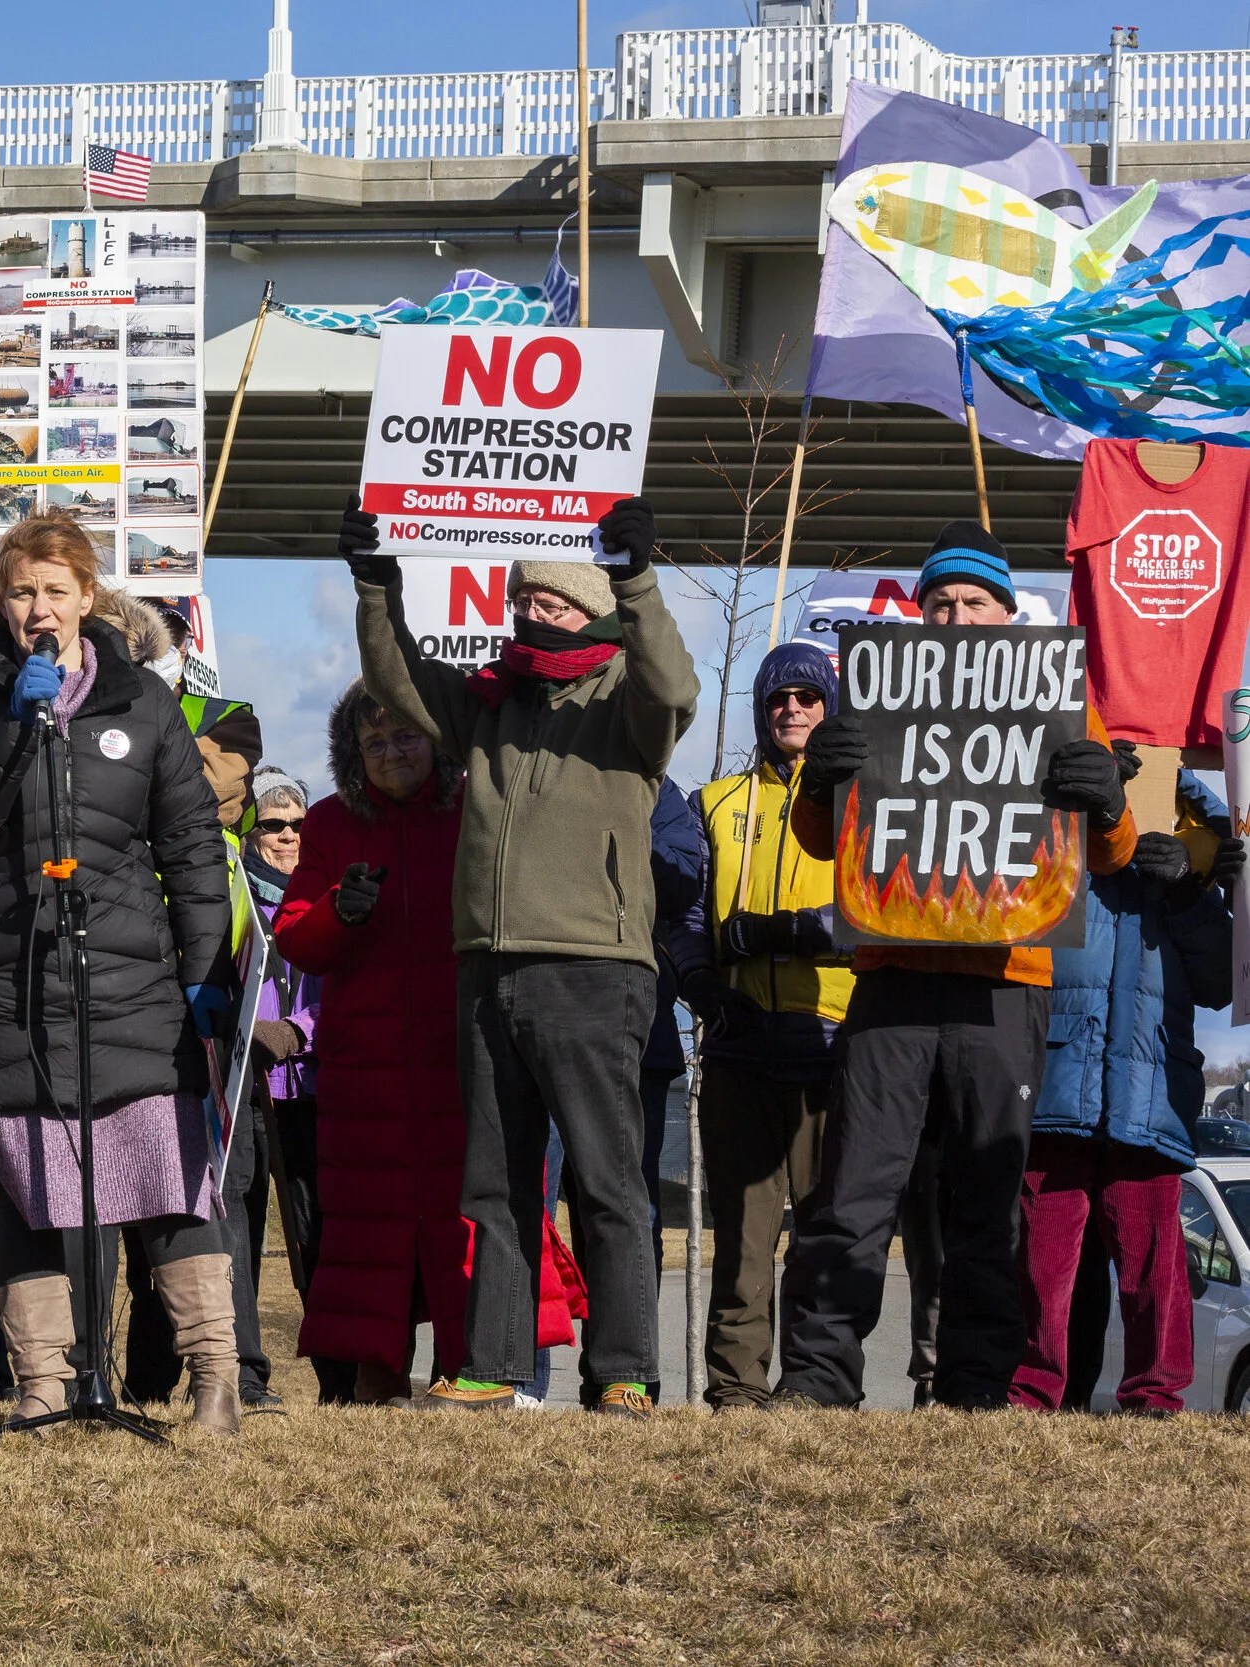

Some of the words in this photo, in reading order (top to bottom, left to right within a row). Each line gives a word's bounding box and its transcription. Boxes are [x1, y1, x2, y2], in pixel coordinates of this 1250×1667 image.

[26, 291, 89, 299] COMPRESSOR
[441, 335, 582, 410] NO
[381, 415, 632, 451] COMPRESSOR
[16, 469, 47, 477] About
[87, 468, 104, 476] Air.
[422, 449, 577, 482] STATION
[402, 489, 468, 511] South
[472, 493, 545, 518] Shore,
[551, 496, 589, 516] MA
[389, 522, 594, 548] NOCompressor.com
[1133, 533, 1200, 558] STOP
[1126, 558, 1178, 569] FRACKED
[1182, 559, 1205, 570] GAS
[1137, 569, 1194, 580] PIPELINES!
[448, 566, 507, 626] N
[867, 578, 923, 617] N
[188, 595, 203, 654] O
[848, 639, 946, 711] OUR
[951, 639, 1086, 712] HOUSE
[900, 723, 951, 785] IS
[962, 724, 1046, 786] ON
[872, 798, 1044, 877] FIRE
